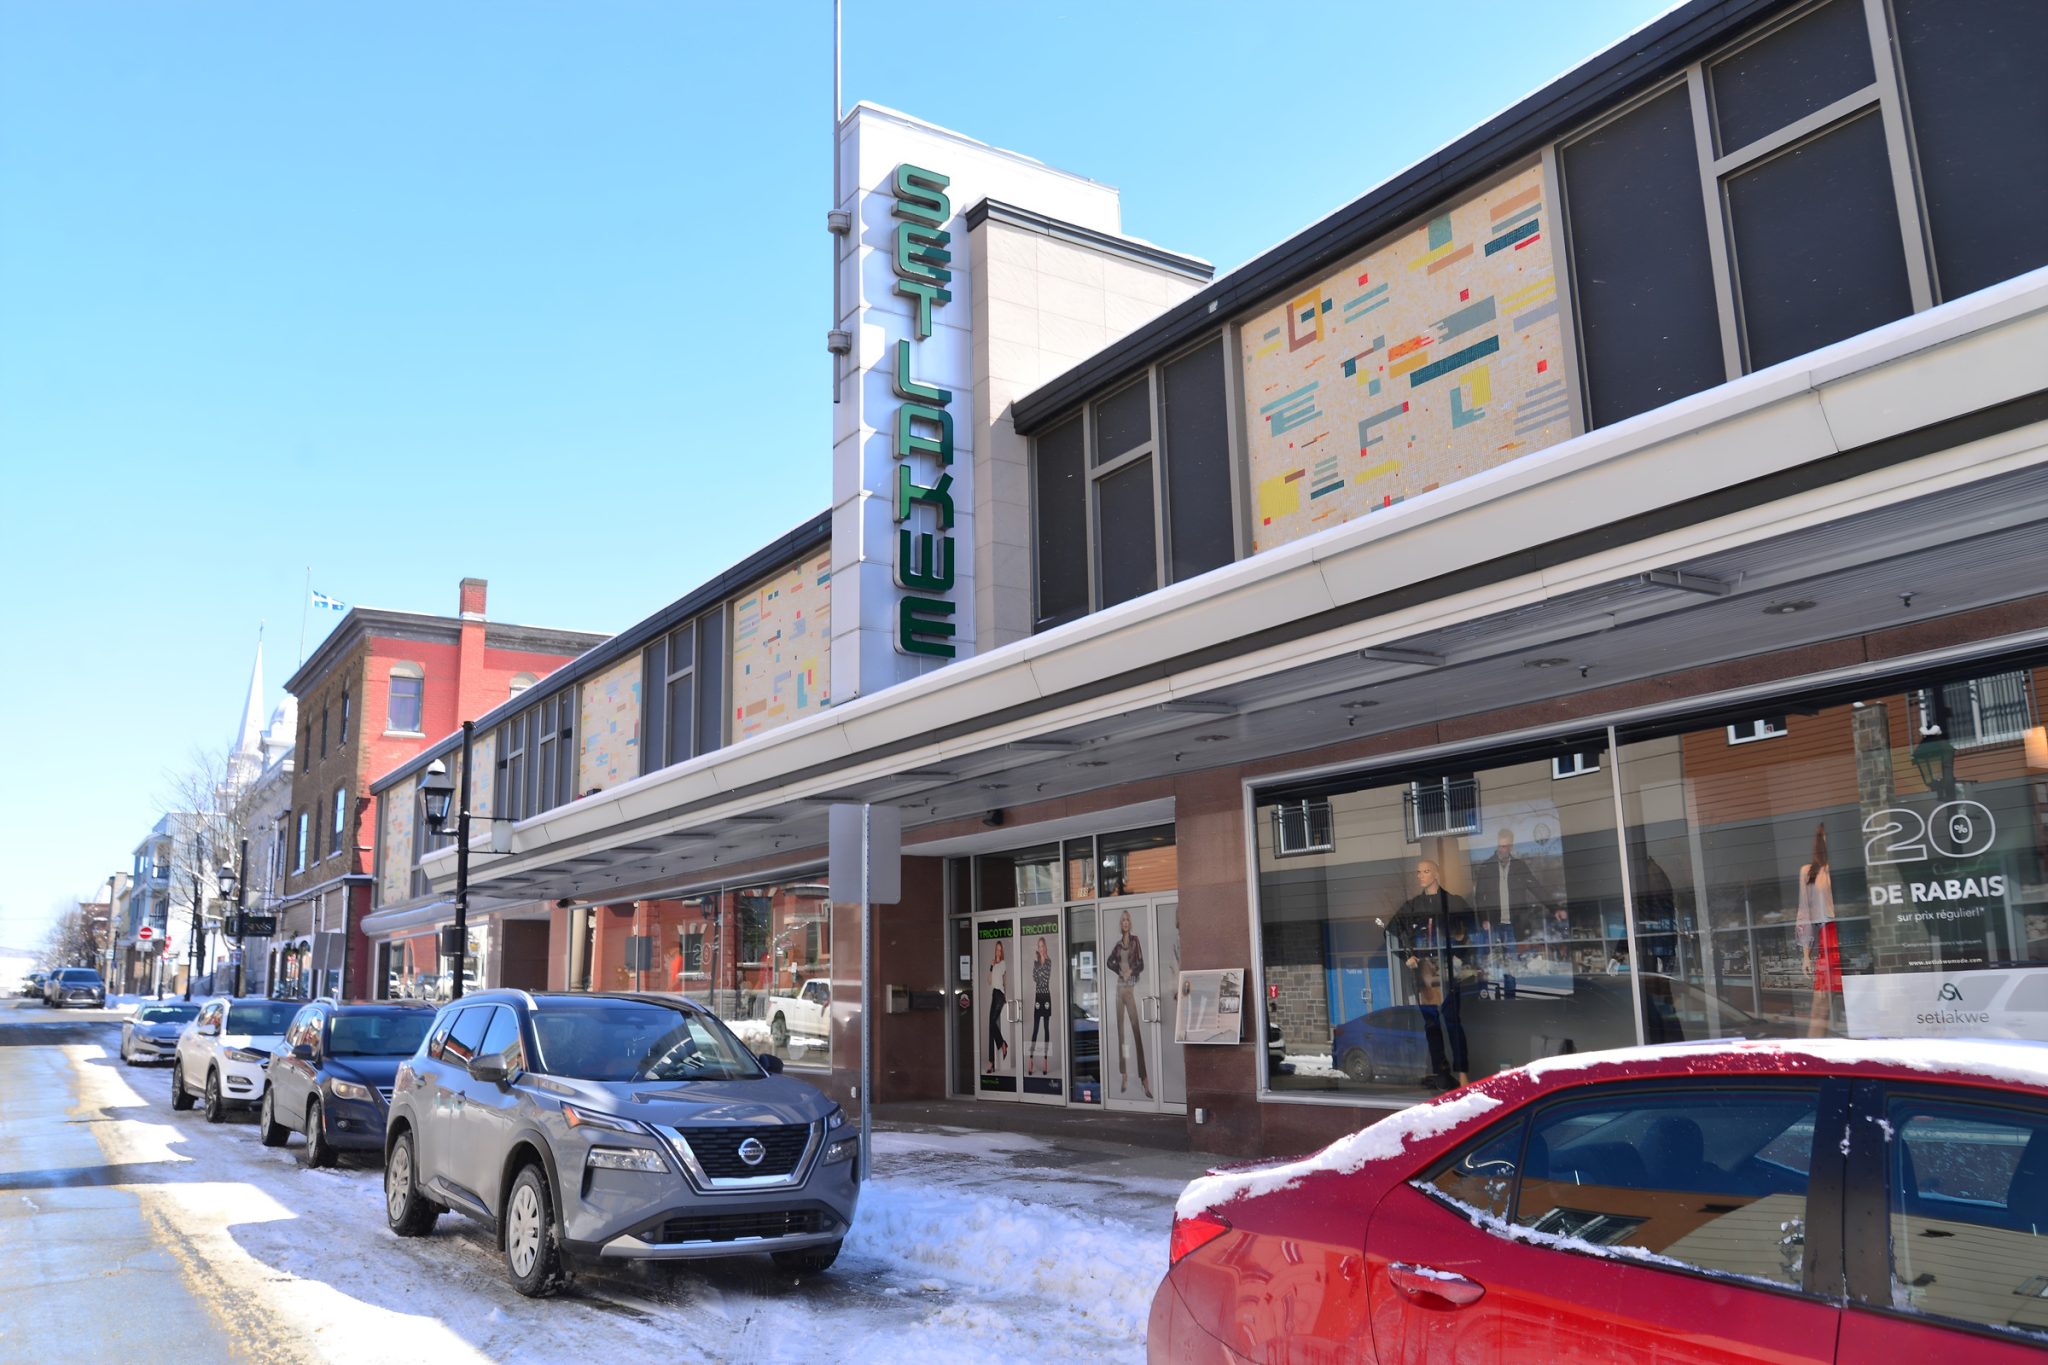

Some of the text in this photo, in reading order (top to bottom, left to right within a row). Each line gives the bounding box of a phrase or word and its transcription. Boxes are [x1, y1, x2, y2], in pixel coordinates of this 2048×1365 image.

[894, 163, 956, 659] SETLAKWE
[1869, 875, 2005, 906] DE RABAIS
[1896, 913, 1912, 922] sur
[1914, 910, 1935, 924] prix
[979, 927, 1013, 939] TRICOTTO
[1021, 922, 1058, 935] TRICOTTO
[1916, 1009, 1990, 1024] setlakwe
